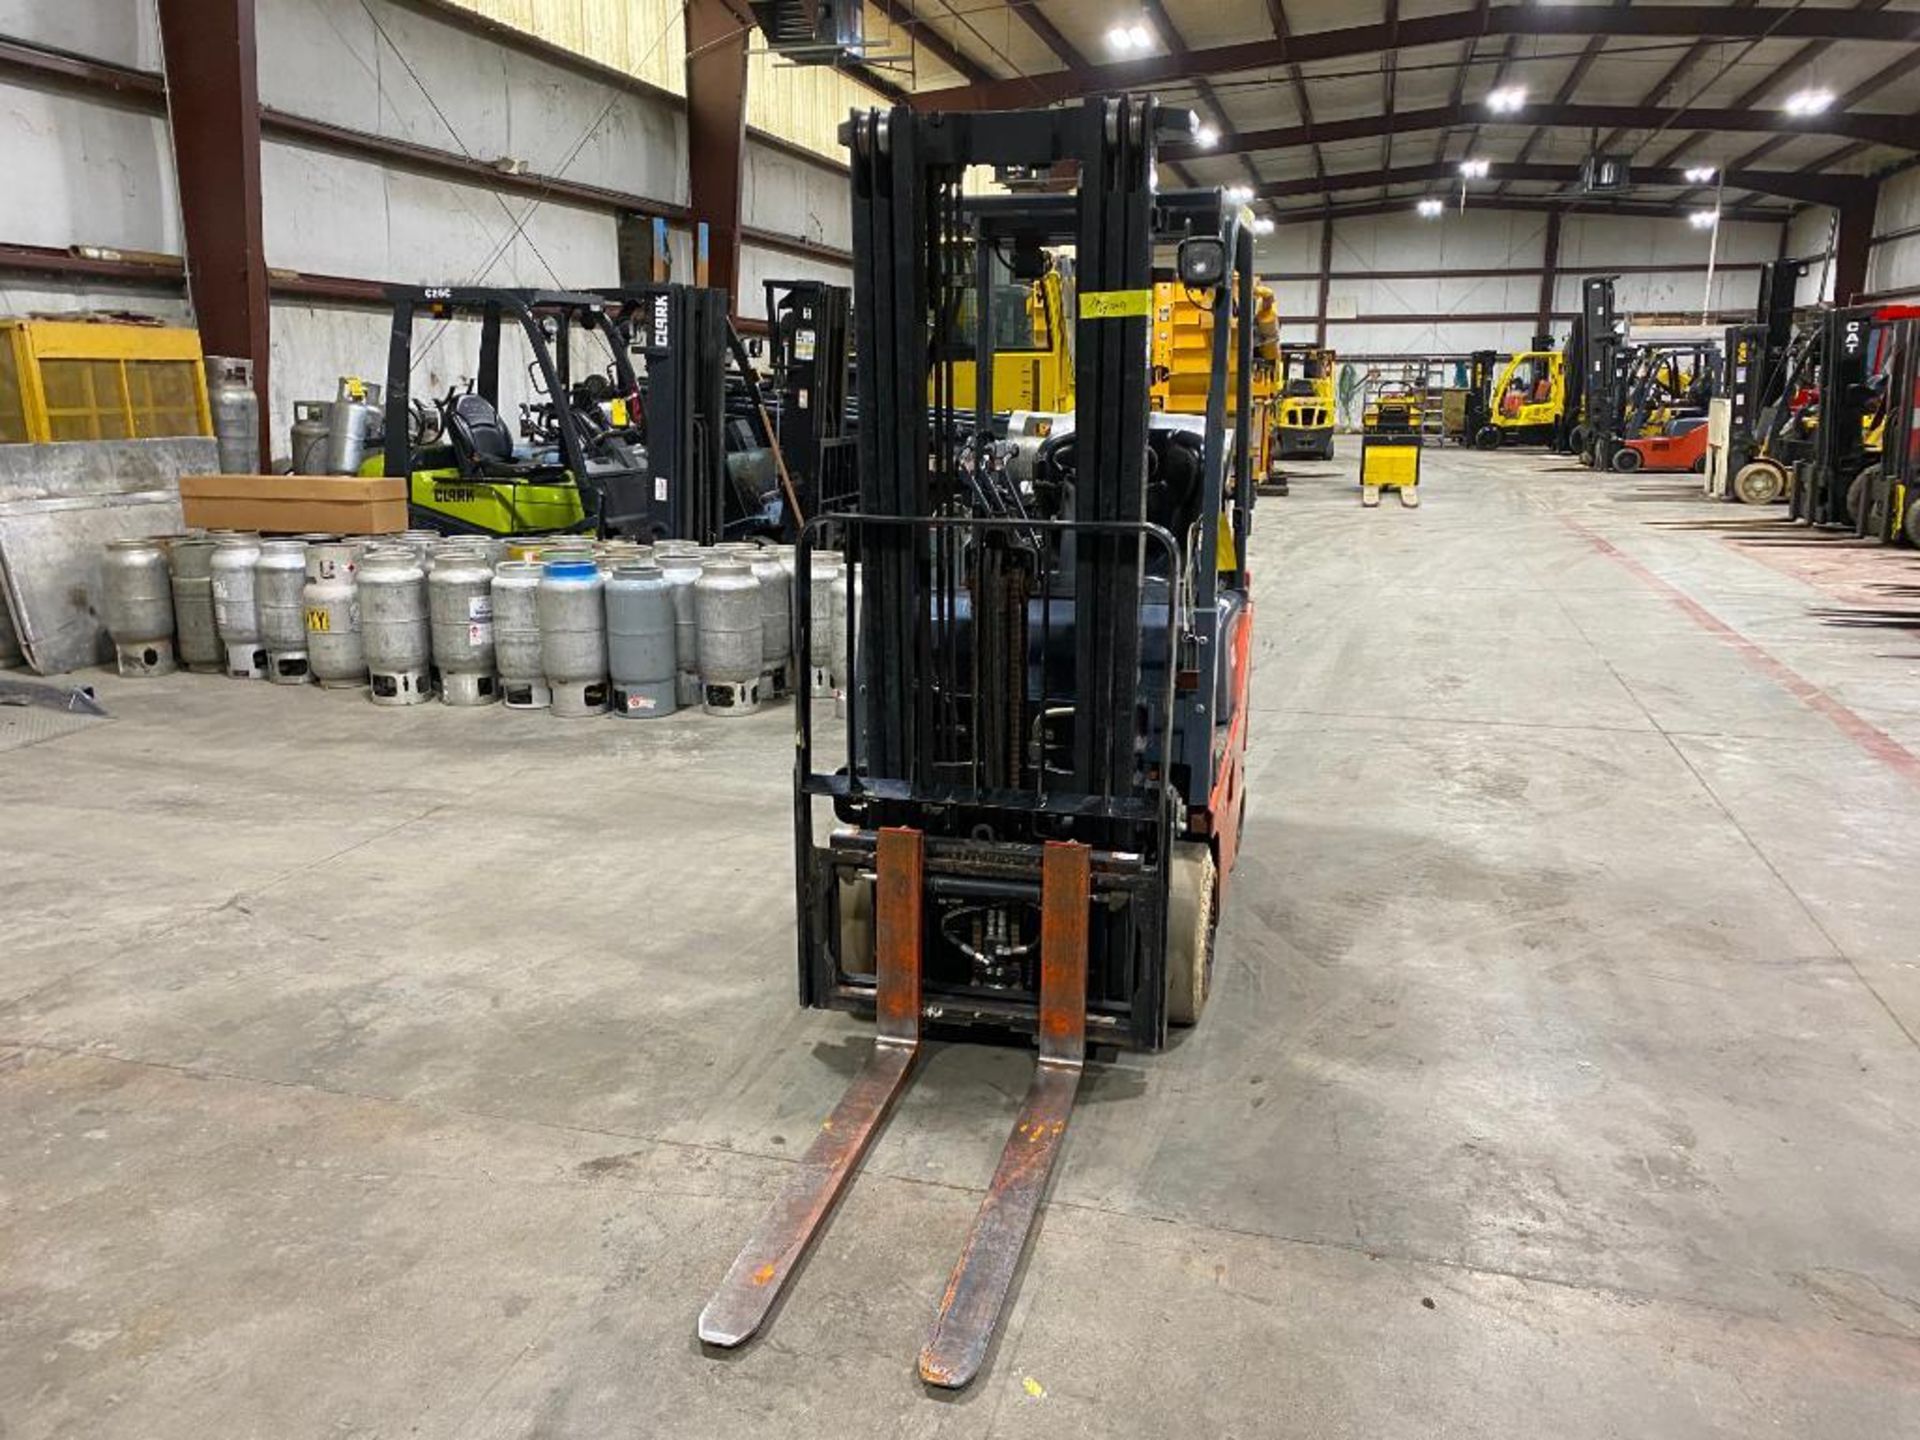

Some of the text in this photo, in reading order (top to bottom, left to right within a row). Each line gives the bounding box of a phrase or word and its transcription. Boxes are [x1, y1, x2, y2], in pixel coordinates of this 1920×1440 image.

[655, 295, 668, 347] CLARK
[1845, 321, 1859, 353] CAT
[434, 488, 475, 503] CLARK
